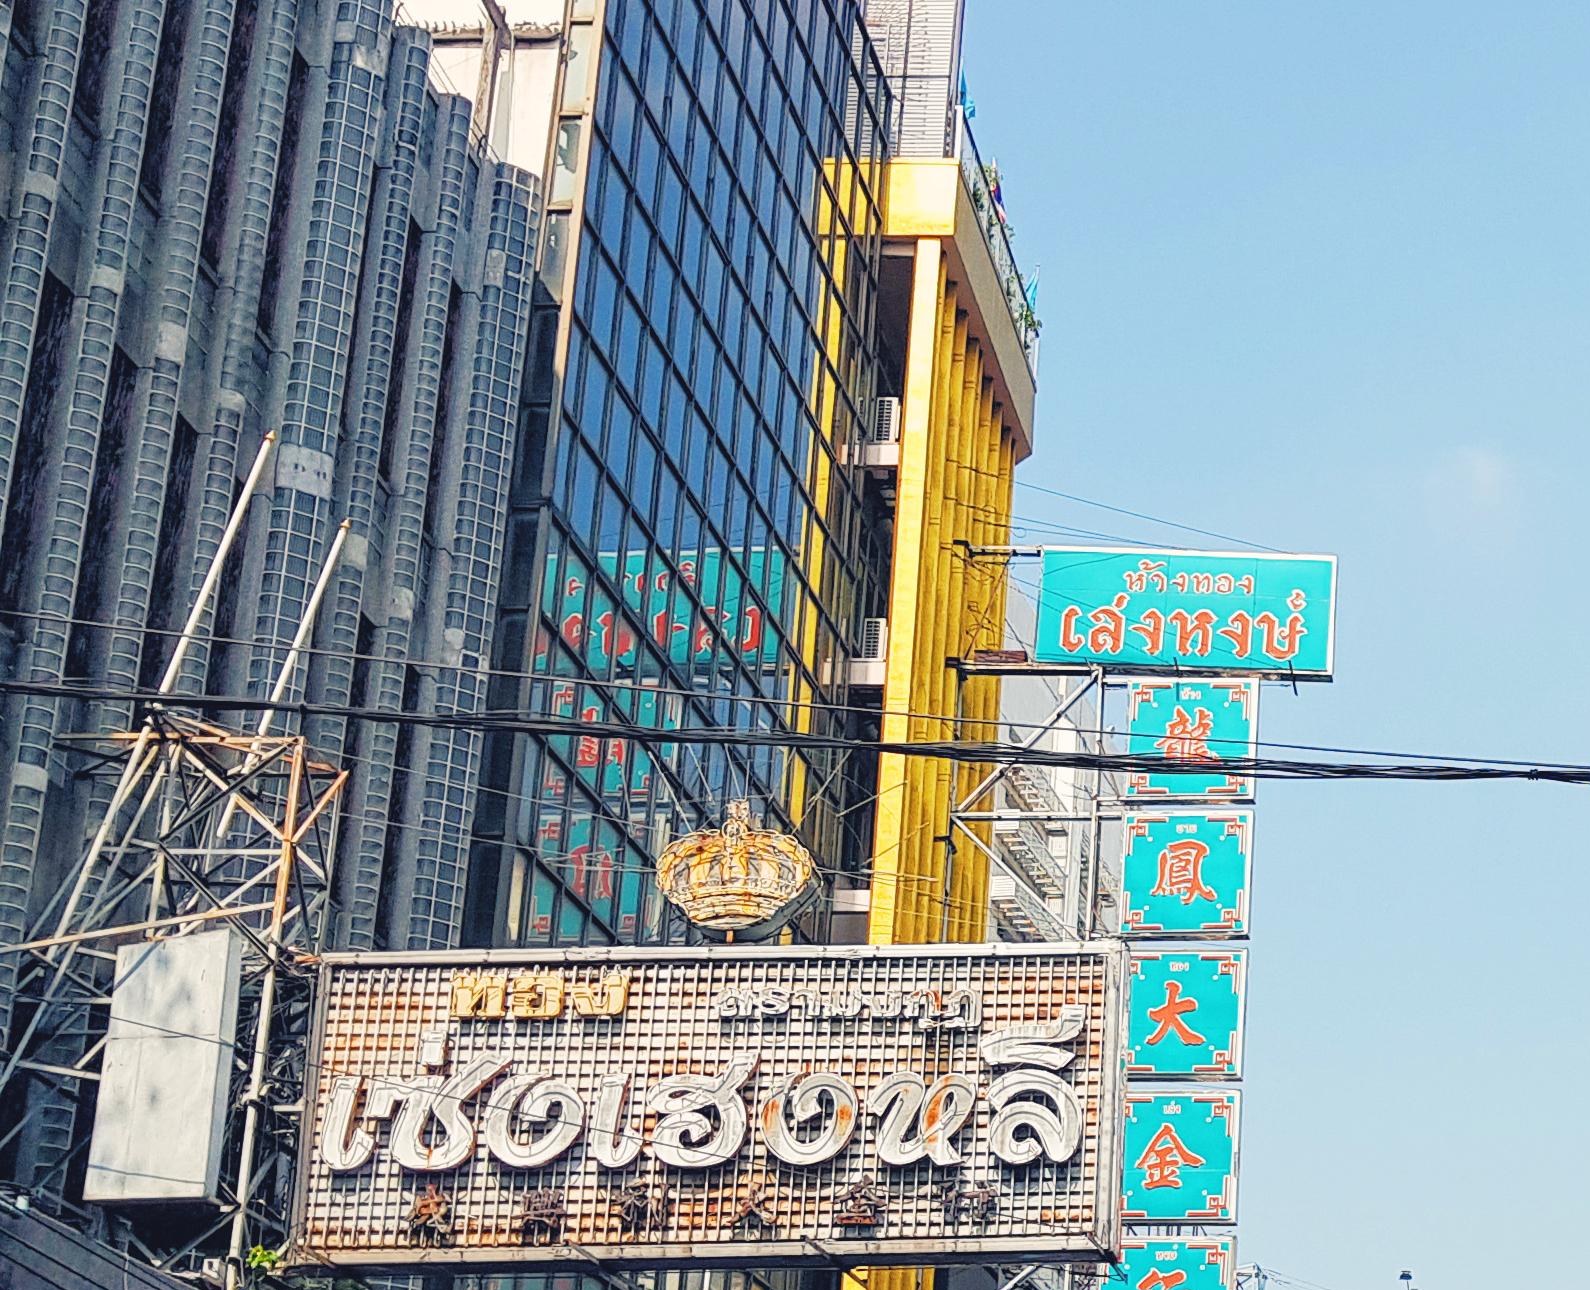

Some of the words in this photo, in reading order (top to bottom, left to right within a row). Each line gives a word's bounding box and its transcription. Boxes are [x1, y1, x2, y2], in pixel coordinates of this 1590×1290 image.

[1123, 559, 1255, 595] ห้างทอง
[1058, 589, 1308, 661] เล่งหงษ์
[449, 972, 632, 1020] ทอง
